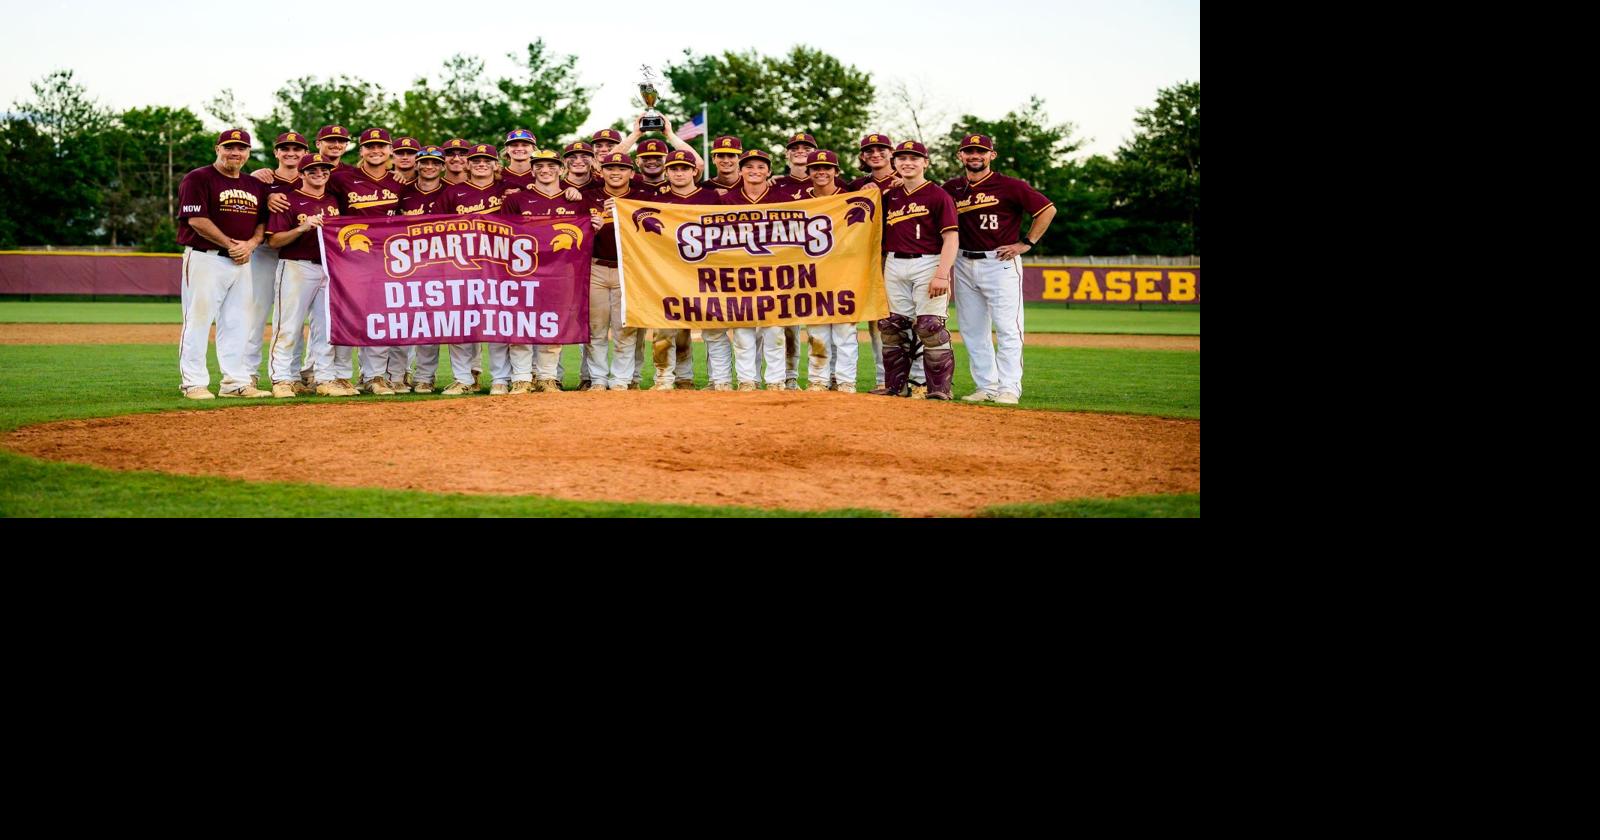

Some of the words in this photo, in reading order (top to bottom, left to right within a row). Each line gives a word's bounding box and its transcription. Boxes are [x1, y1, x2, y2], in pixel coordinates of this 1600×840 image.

[348, 190, 378, 203] Broad
[975, 192, 996, 204] Run
[456, 199, 485, 214] Broad
[906, 202, 927, 214] Run
[703, 211, 761, 225] BROAD
[769, 211, 803, 221] RUN
[980, 214, 999, 230] 28
[412, 222, 469, 236] BROAD
[477, 222, 509, 235] RUN
[916, 224, 921, 240] 1
[681, 218, 829, 259] SPARTANS
[389, 233, 533, 274] SPARTANS
[697, 263, 818, 293] REGION
[1042, 270, 1199, 301] BASEB
[384, 278, 540, 308] DISTRICT
[662, 290, 856, 322] CHAMPIONS
[366, 309, 560, 340] CHAMPIONS
